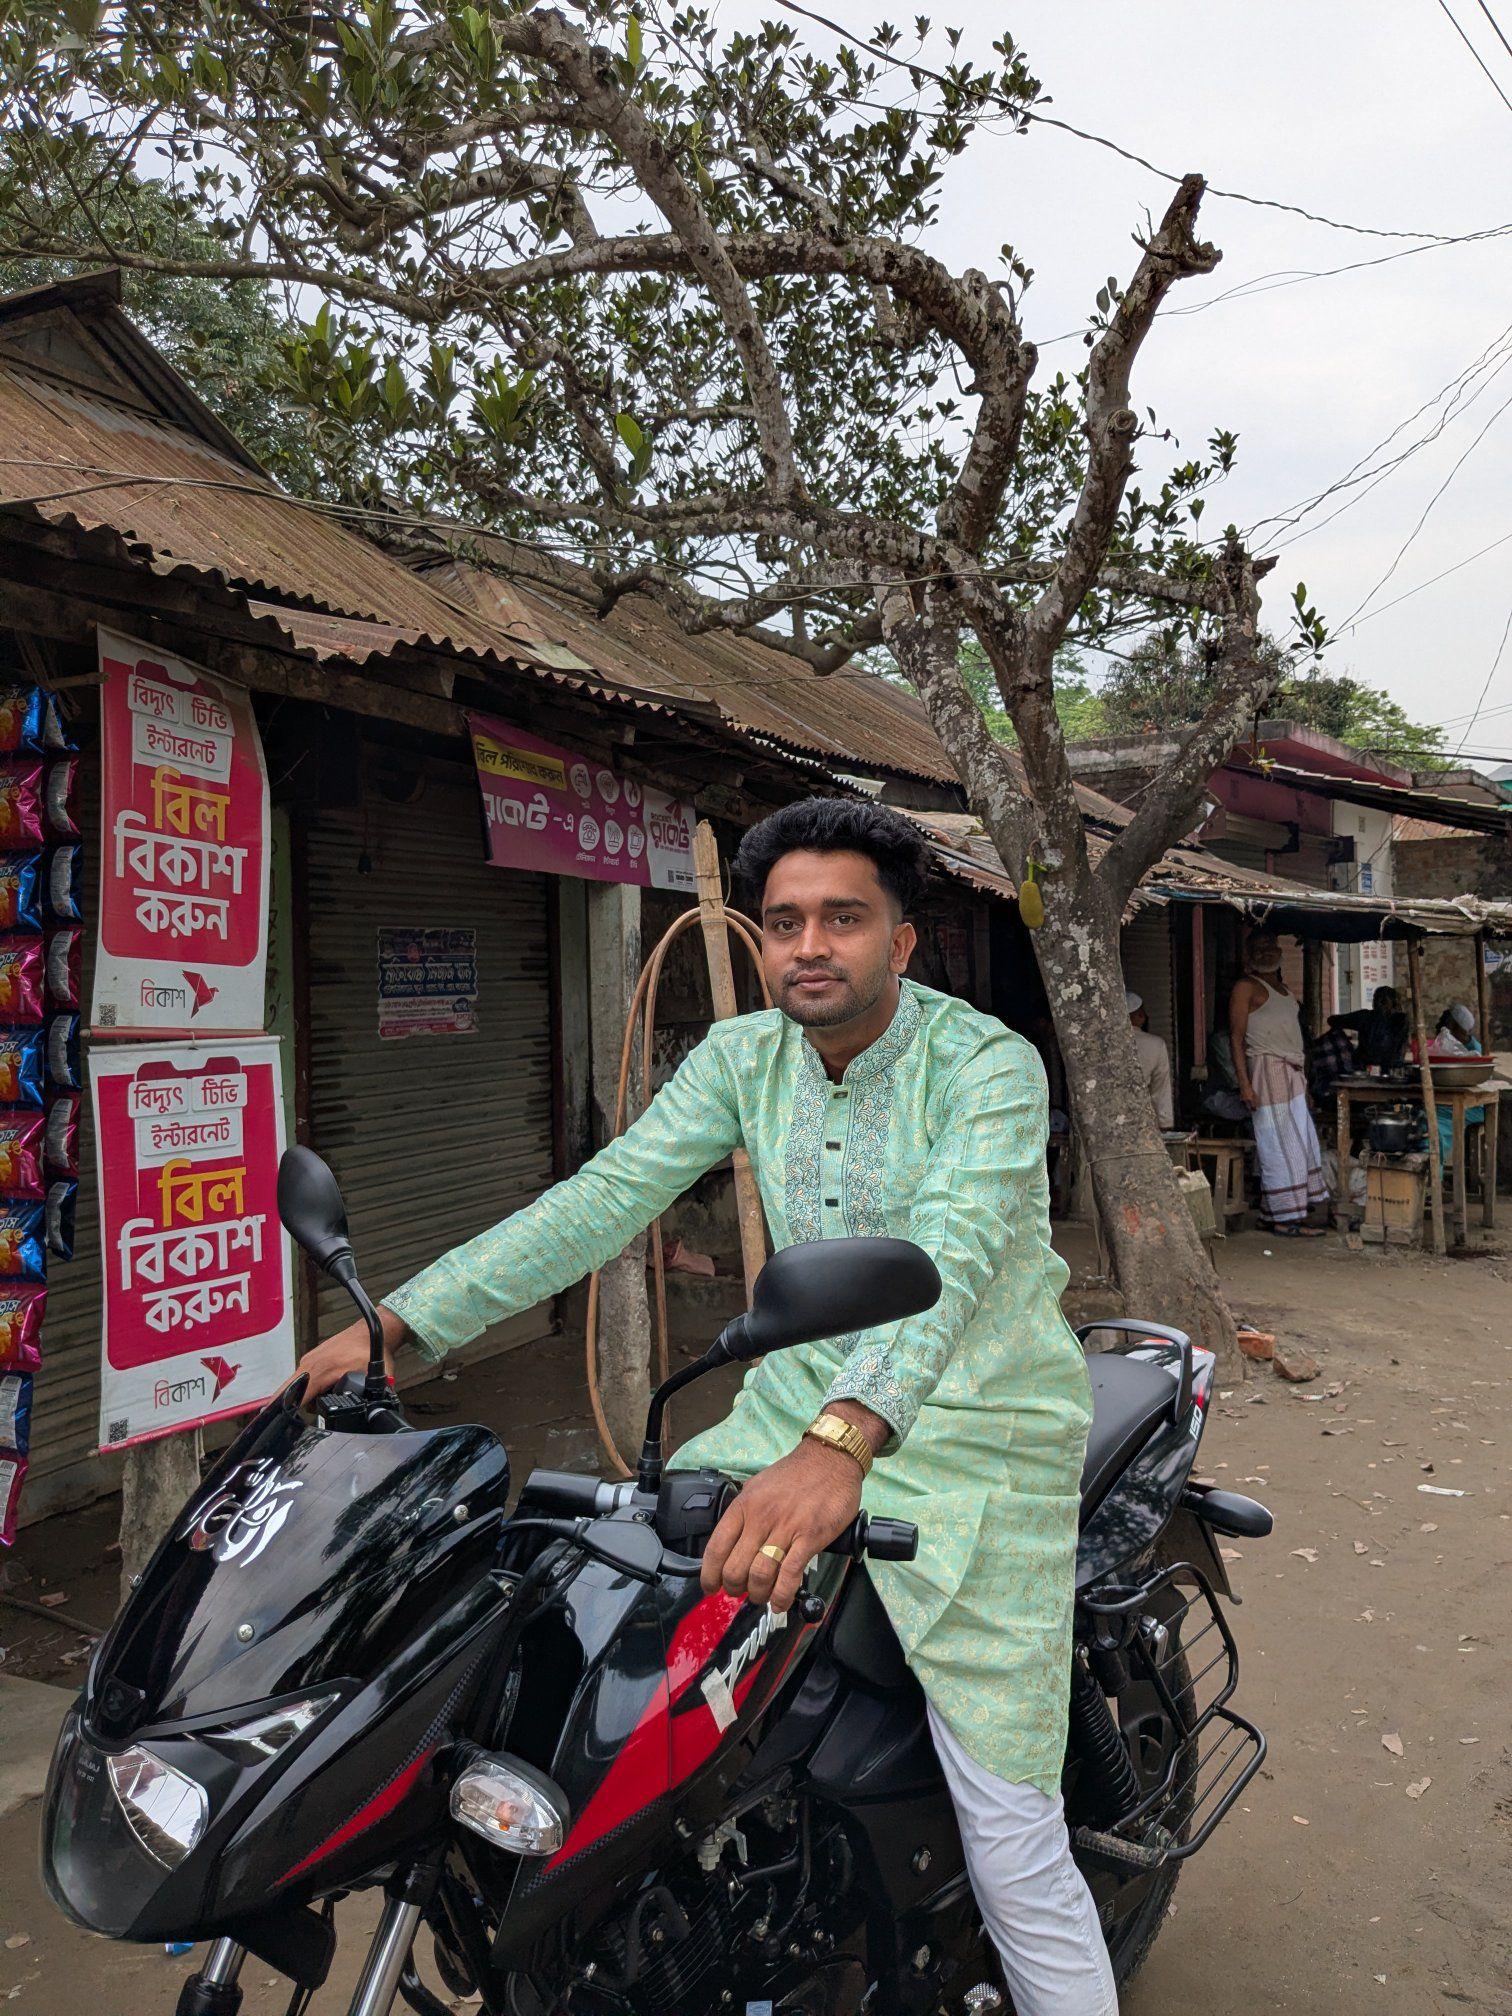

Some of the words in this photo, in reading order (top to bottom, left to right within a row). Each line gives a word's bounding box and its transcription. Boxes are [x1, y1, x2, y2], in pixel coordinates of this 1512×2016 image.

[133, 678, 176, 717] বিদ্যুৎ
[190, 696, 229, 731] টিভি
[146, 724, 217, 765] ইন্টারনেট
[150, 764, 231, 842] বিল
[113, 809, 248, 895] বিকাশ
[650, 817, 690, 849] রকেট
[133, 886, 230, 941] করুন
[140, 978, 186, 1009] বিকাশ
[134, 1081, 184, 1113] বিদ্যুৎ
[201, 1077, 240, 1107] টিভি
[151, 1116, 231, 1149] ইন্টারনেট
[157, 1157, 247, 1228] বিল
[117, 1213, 266, 1291] বিকাশ
[142, 1271, 251, 1334] করুন
[154, 1376, 206, 1410] বিকাশ
[1189, 1404, 1203, 1440] 150
